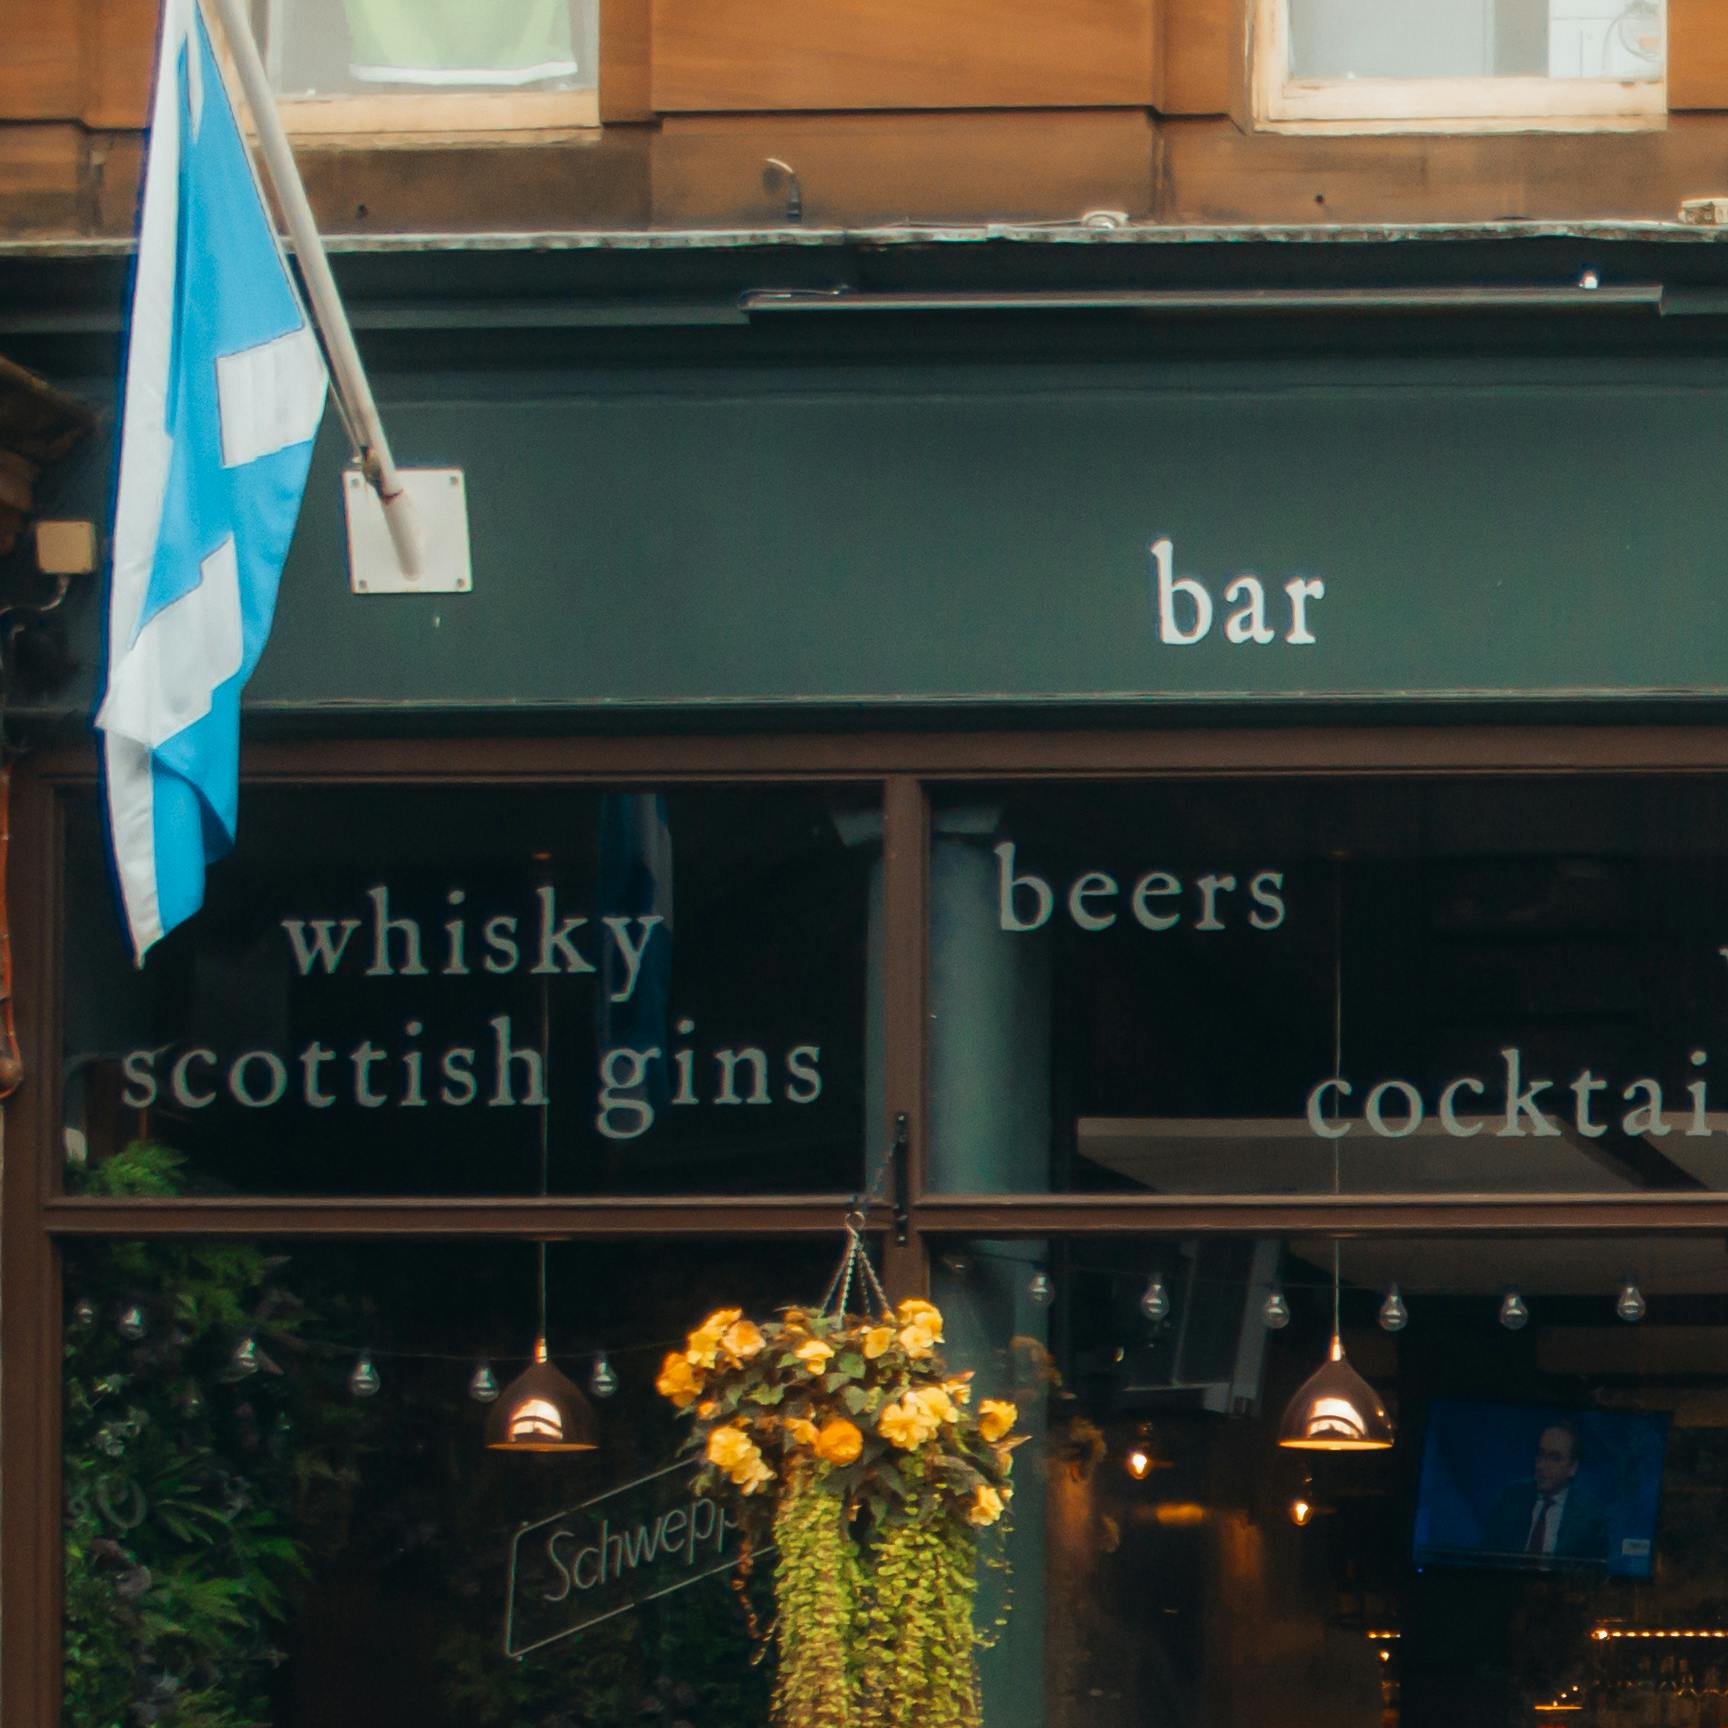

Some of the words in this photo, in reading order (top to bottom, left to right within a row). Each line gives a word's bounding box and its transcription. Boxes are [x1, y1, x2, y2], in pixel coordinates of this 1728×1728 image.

[1150, 539, 1325, 645] bar
[994, 842, 1286, 932] beers
[280, 885, 665, 1003] whisky
[121, 1015, 550, 1109] scottish
[596, 1019, 823, 1139] gins
